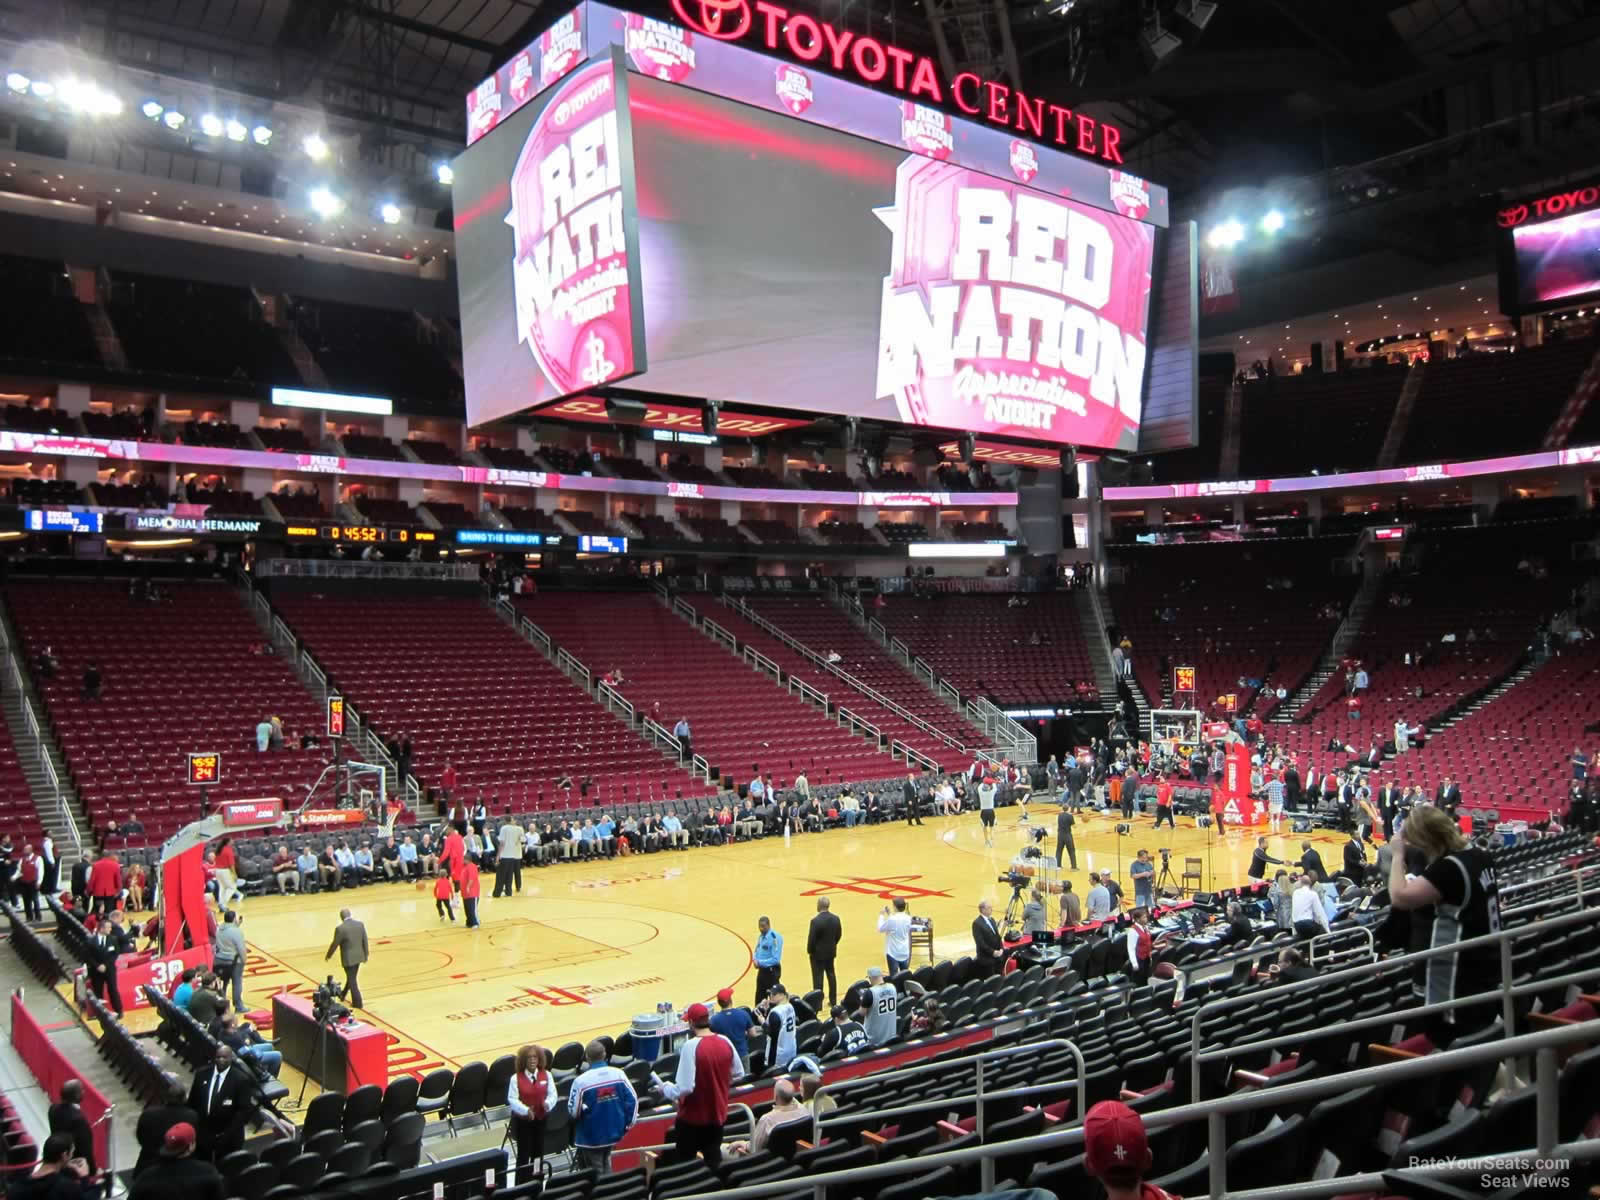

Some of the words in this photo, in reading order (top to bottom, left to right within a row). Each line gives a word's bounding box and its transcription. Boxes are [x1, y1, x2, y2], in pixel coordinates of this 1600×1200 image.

[629, 29, 695, 69] NATION
[570, 75, 611, 115] TOYOTA
[757, 3, 942, 101] TOYOTA
[952, 72, 1123, 163] CENTER
[1532, 187, 1599, 217] TOYO
[952, 187, 1114, 310] RED
[876, 277, 1146, 427] NATION
[955, 365, 1087, 417] Appreciation
[984, 394, 1056, 430] NIGHT
[138, 517, 198, 530] MEMORIAL
[201, 521, 261, 532] HERMANN
[344, 528, 377, 541] 45:52
[1178, 677, 1192, 689] 24
[196, 768, 212, 780] 24
[231, 804, 255, 814] TOYOTA
[446, 999, 542, 1021] ROCKETS
[879, 998, 896, 1014] 20
